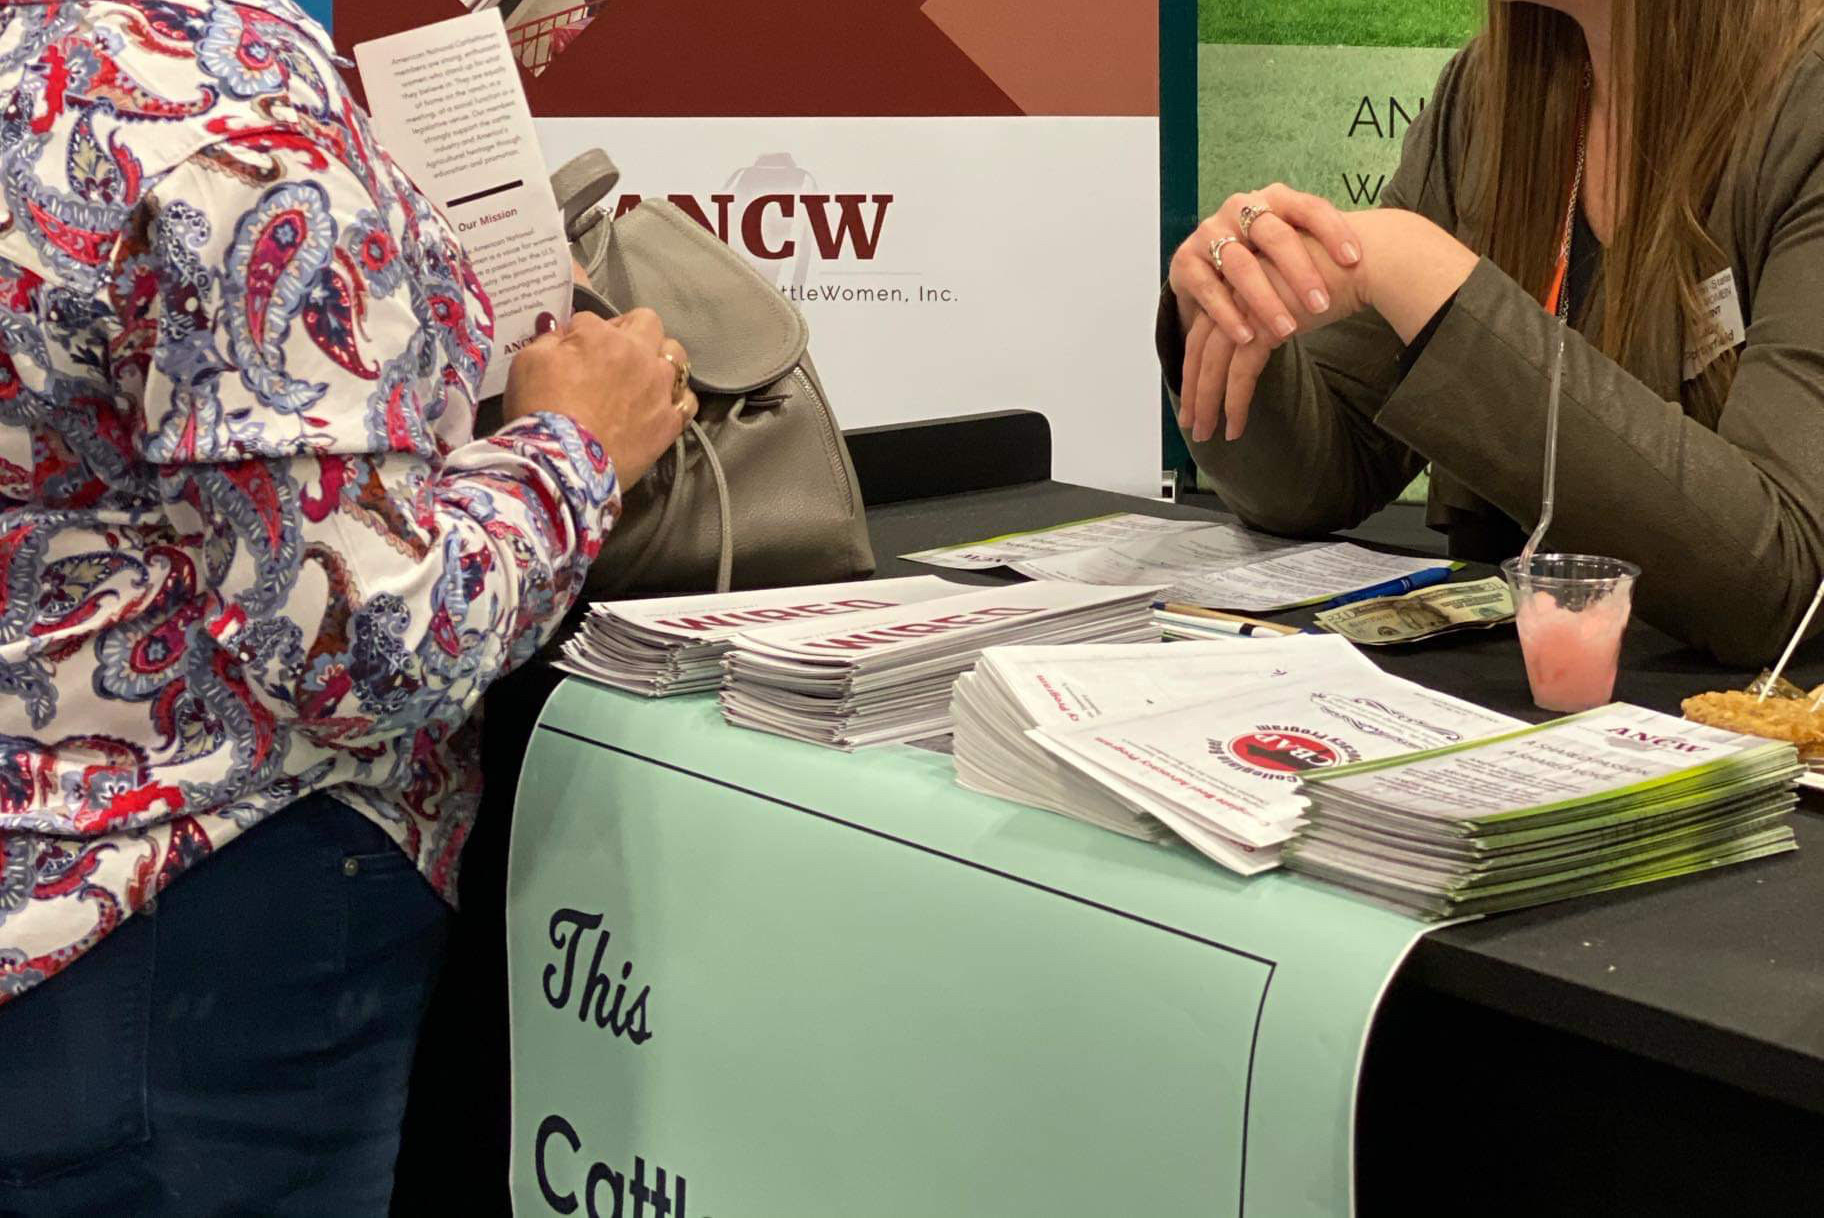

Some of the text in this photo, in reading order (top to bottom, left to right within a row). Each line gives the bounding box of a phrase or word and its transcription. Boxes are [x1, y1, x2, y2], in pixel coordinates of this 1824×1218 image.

[458, 208, 518, 232] Our Mission
[919, 285, 959, 302] Inc.
[1606, 727, 1711, 754] ANCW
[542, 907, 653, 1046] This
[535, 1114, 713, 1218] Cattl
